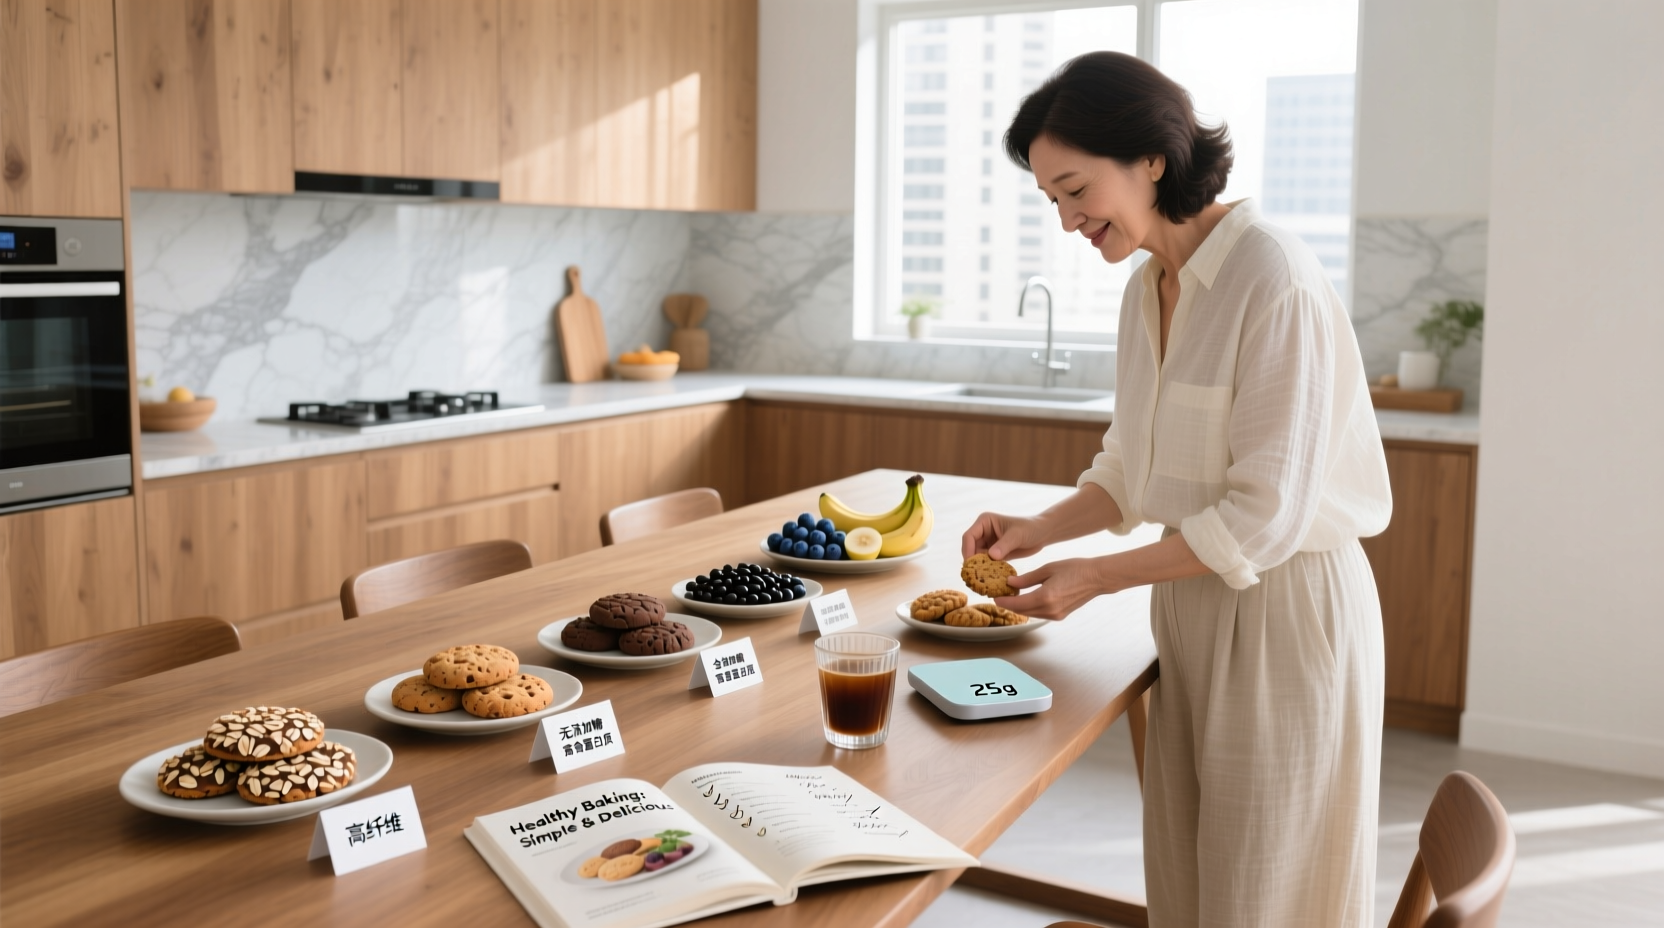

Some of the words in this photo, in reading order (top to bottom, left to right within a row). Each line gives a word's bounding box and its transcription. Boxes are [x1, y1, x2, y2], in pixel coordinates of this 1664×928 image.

[970, 682, 1018, 696] 25g
[345, 812, 404, 847] 高纤维
[510, 807, 577, 835] Healthy
[581, 791, 646, 811] Baking:
[520, 825, 577, 848] Simple
[581, 817, 595, 829] &
